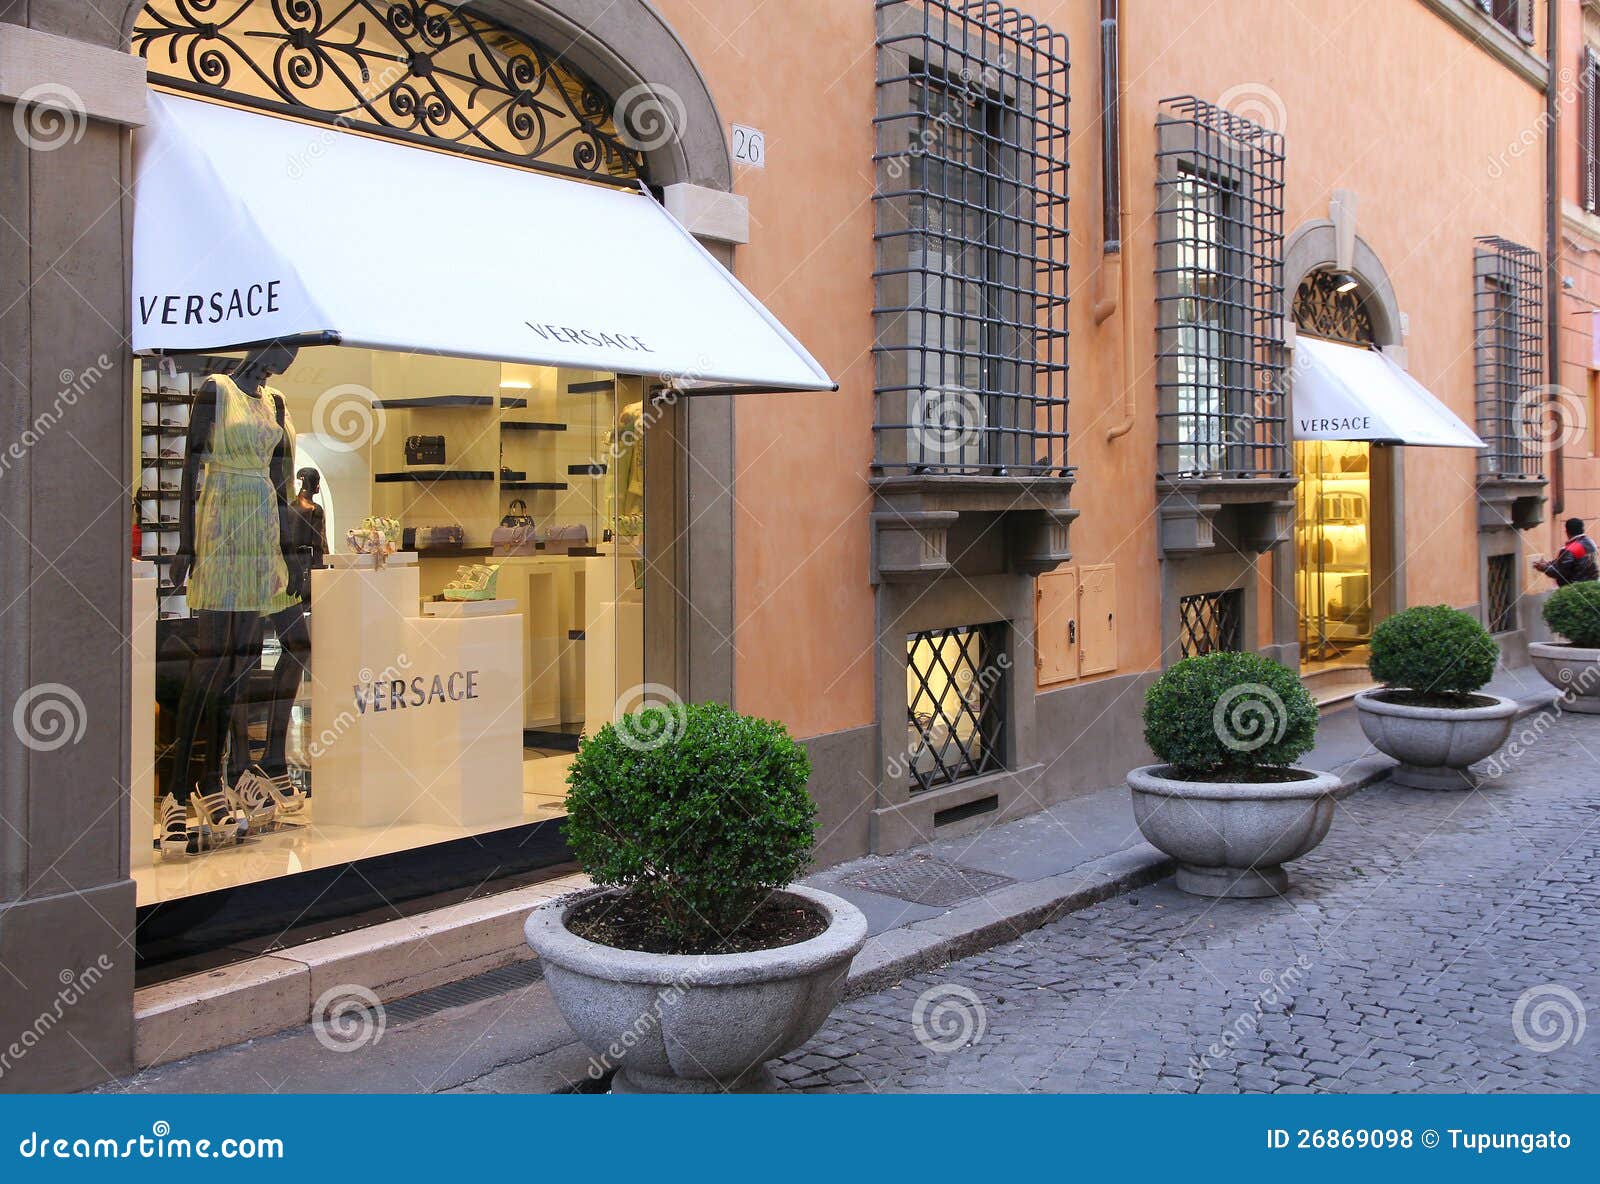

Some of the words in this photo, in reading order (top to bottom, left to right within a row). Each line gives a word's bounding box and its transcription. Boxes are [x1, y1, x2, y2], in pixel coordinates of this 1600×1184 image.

[734, 129, 762, 163] 26
[139, 280, 281, 325] VERSACE
[525, 321, 655, 352] VERSACE
[1301, 416, 1371, 432] VERSACE
[353, 670, 480, 714] VERSACE
